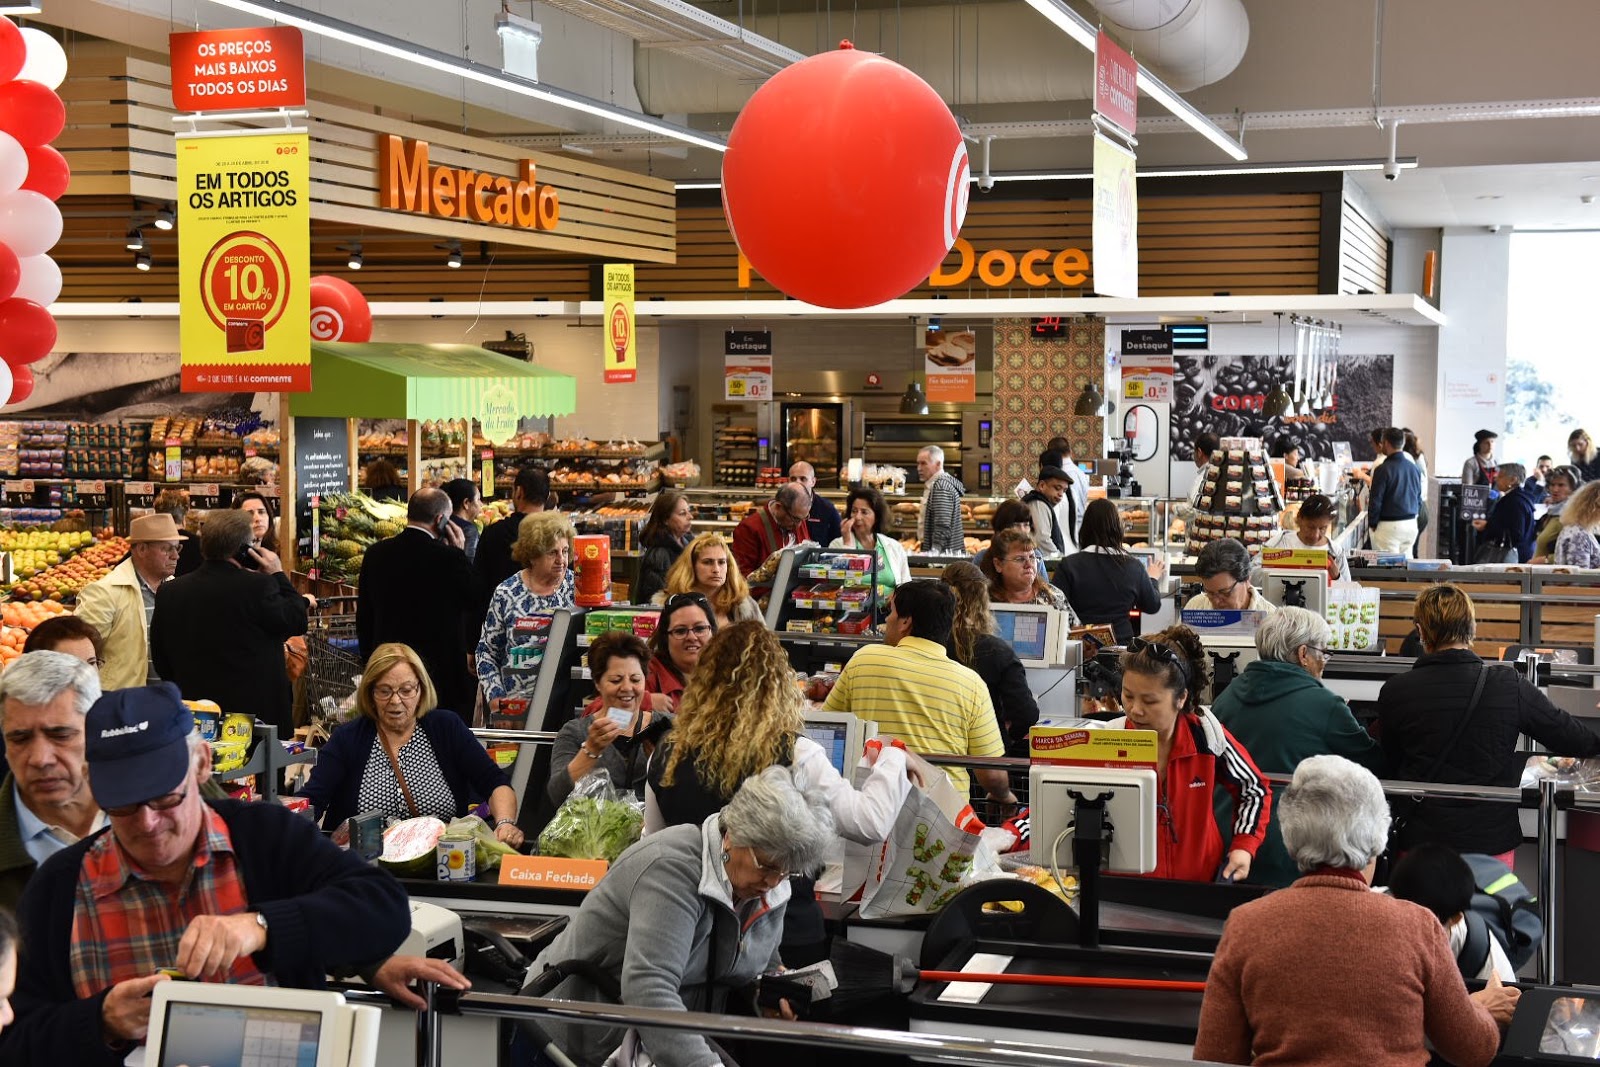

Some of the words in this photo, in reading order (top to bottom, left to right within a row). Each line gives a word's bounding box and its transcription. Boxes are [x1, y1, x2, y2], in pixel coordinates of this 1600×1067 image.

[198, 43, 216, 57] OS
[219, 40, 272, 58] PREÇOS
[194, 62, 226, 77] MAIS
[229, 59, 277, 75] BAIXOS
[188, 82, 234, 97] TODOS
[237, 80, 256, 93] OS
[258, 78, 289, 93] DIAS
[196, 173, 221, 190] EM
[226, 170, 289, 189] TODOS
[379, 132, 560, 231] Mercado
[189, 192, 214, 209] OS
[218, 190, 297, 208] ARTIGOS
[224, 255, 265, 264] DESCONTO
[928, 237, 1090, 287] Doce
[224, 263, 272, 301] 10%
[608, 272, 614, 281] EM
[615, 273, 630, 282] TODOS
[607, 282, 613, 291] OS
[613, 283, 632, 292] ARTIGOS
[223, 303, 234, 311] EM
[236, 301, 267, 311] CARTÃO
[1036, 316, 1060, 332] 24
[730, 342, 767, 351] Destaque
[1126, 341, 1169, 351] Destaque
[486, 401, 515, 414] Mercado
[1465, 488, 1479, 498] FILA
[1463, 496, 1484, 507] ÚNICA
[1035, 737, 1054, 745] MARCA
[1063, 732, 1087, 741] SEMANA
[510, 868, 542, 881] Caixa
[545, 870, 595, 885] Fechada
